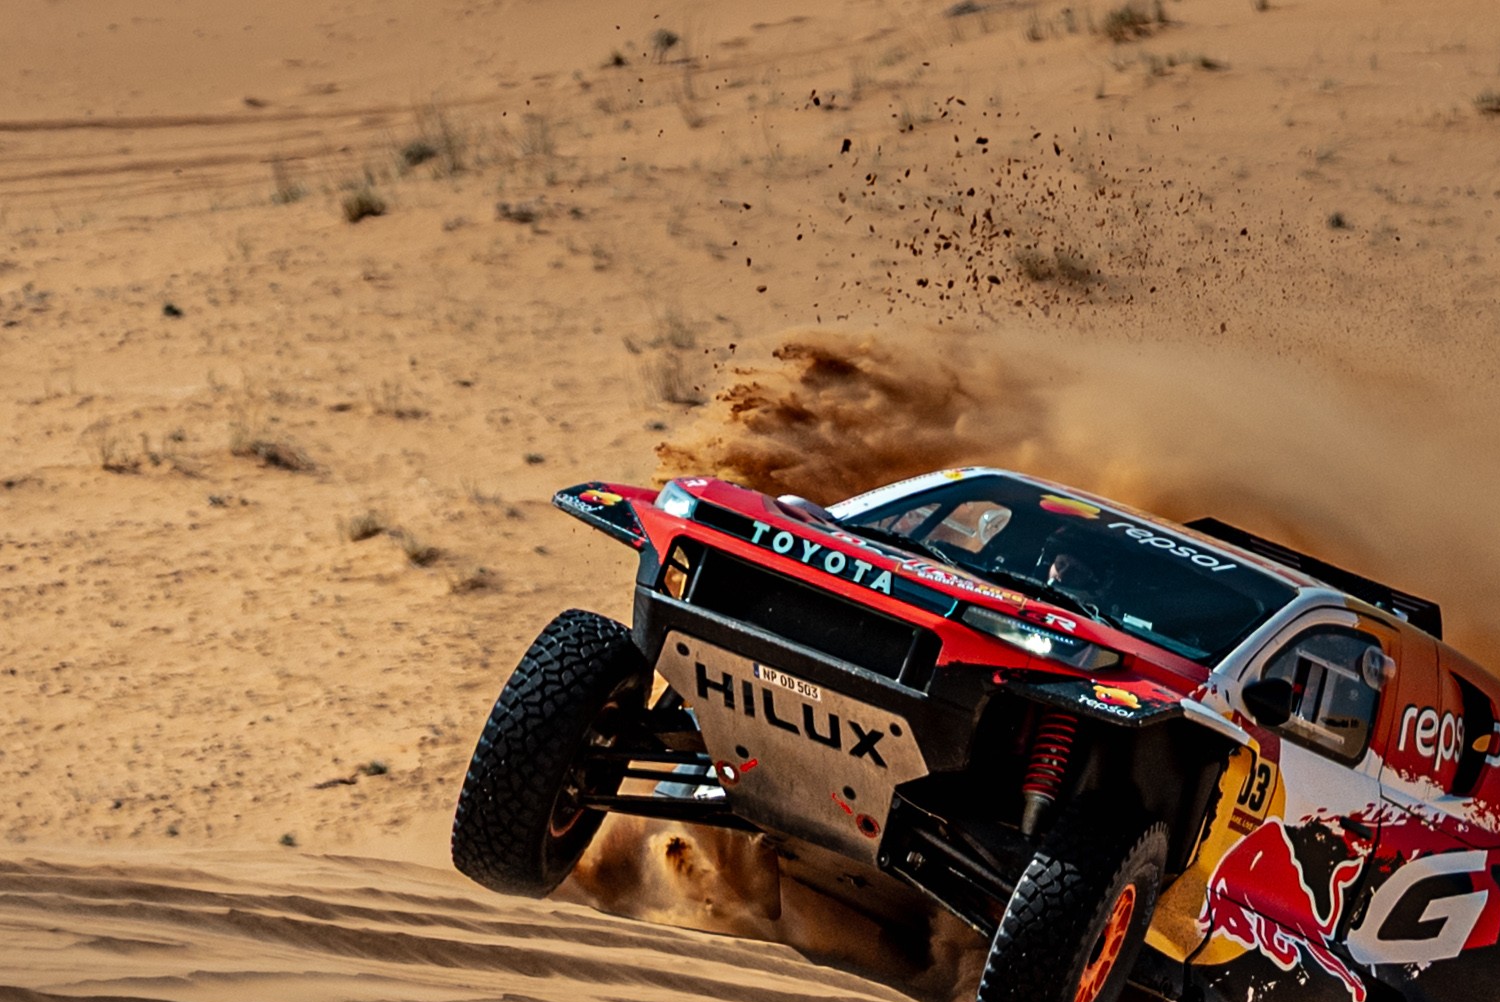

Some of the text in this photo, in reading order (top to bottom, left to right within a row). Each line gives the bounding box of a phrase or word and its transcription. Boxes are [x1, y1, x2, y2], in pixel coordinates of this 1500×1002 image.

[751, 520, 893, 596] TOYOTA
[1107, 521, 1237, 573] repsol
[762, 668, 778, 683] NP
[797, 681, 820, 699] 503
[1079, 694, 1135, 718] repsol
[694, 661, 889, 770] HILUX
